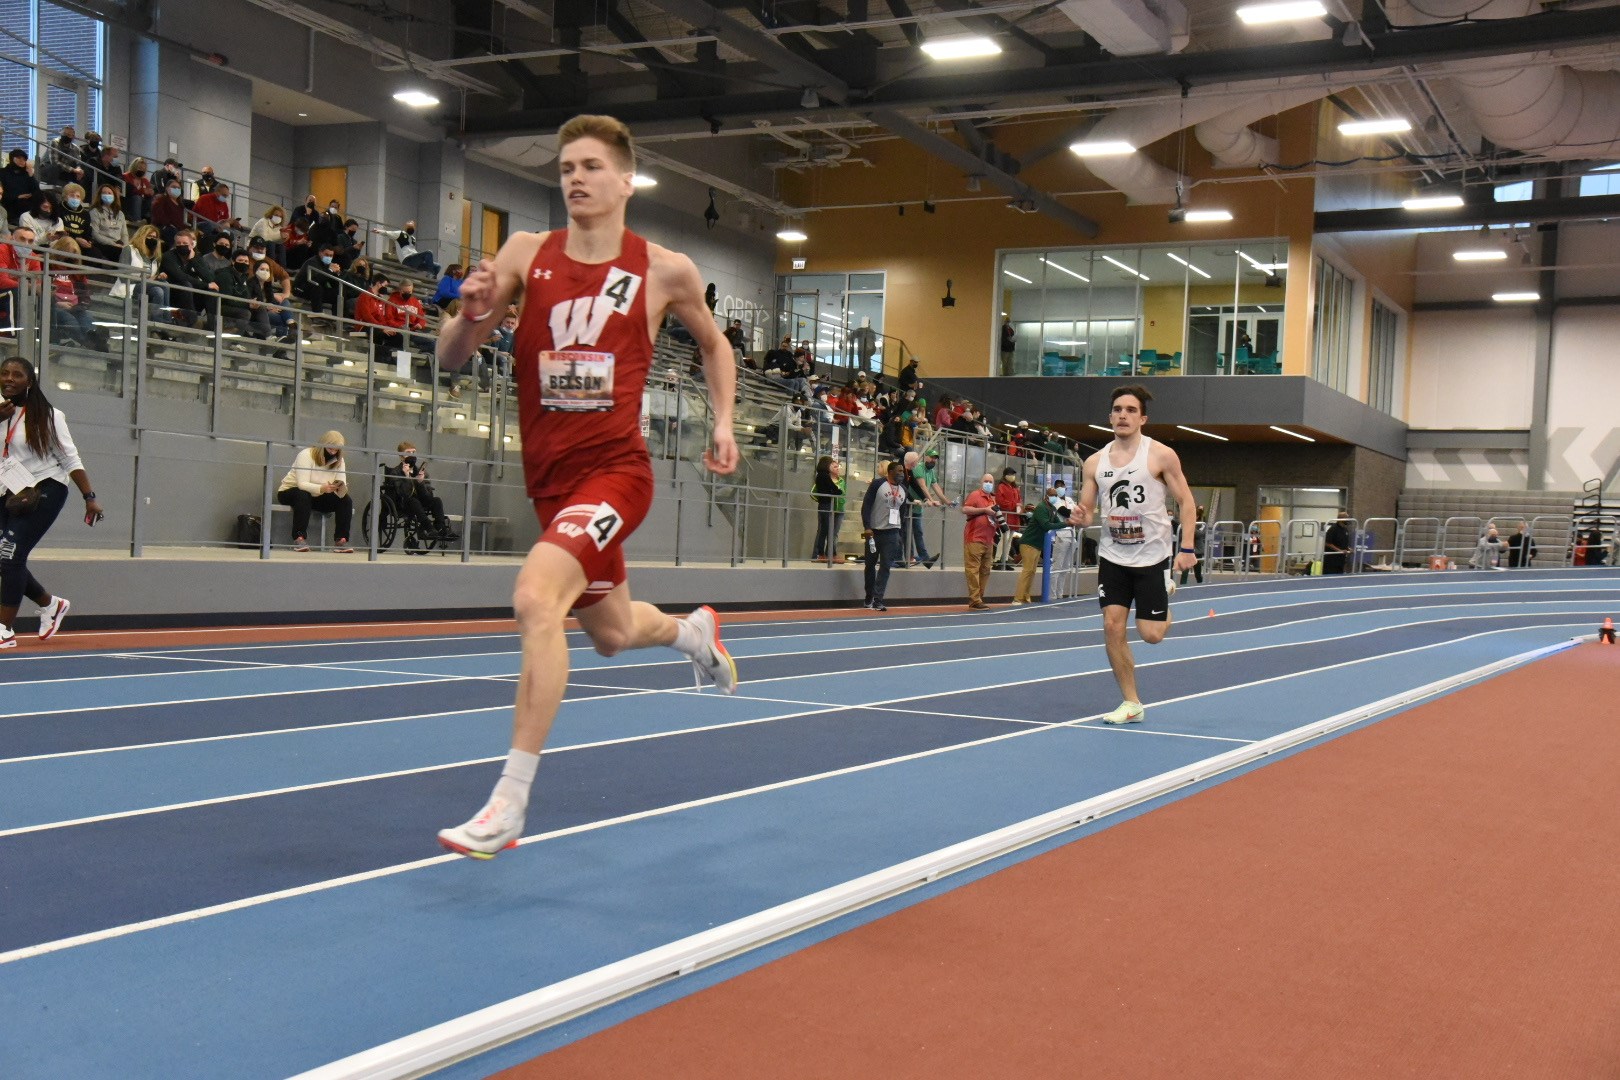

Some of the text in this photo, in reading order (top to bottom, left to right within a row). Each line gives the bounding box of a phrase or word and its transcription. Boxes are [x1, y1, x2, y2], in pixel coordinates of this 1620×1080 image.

[604, 275, 633, 309] 4
[548, 296, 617, 351] W
[549, 375, 602, 390] BELSON
[1133, 485, 1146, 504] 3
[593, 514, 618, 544] 4
